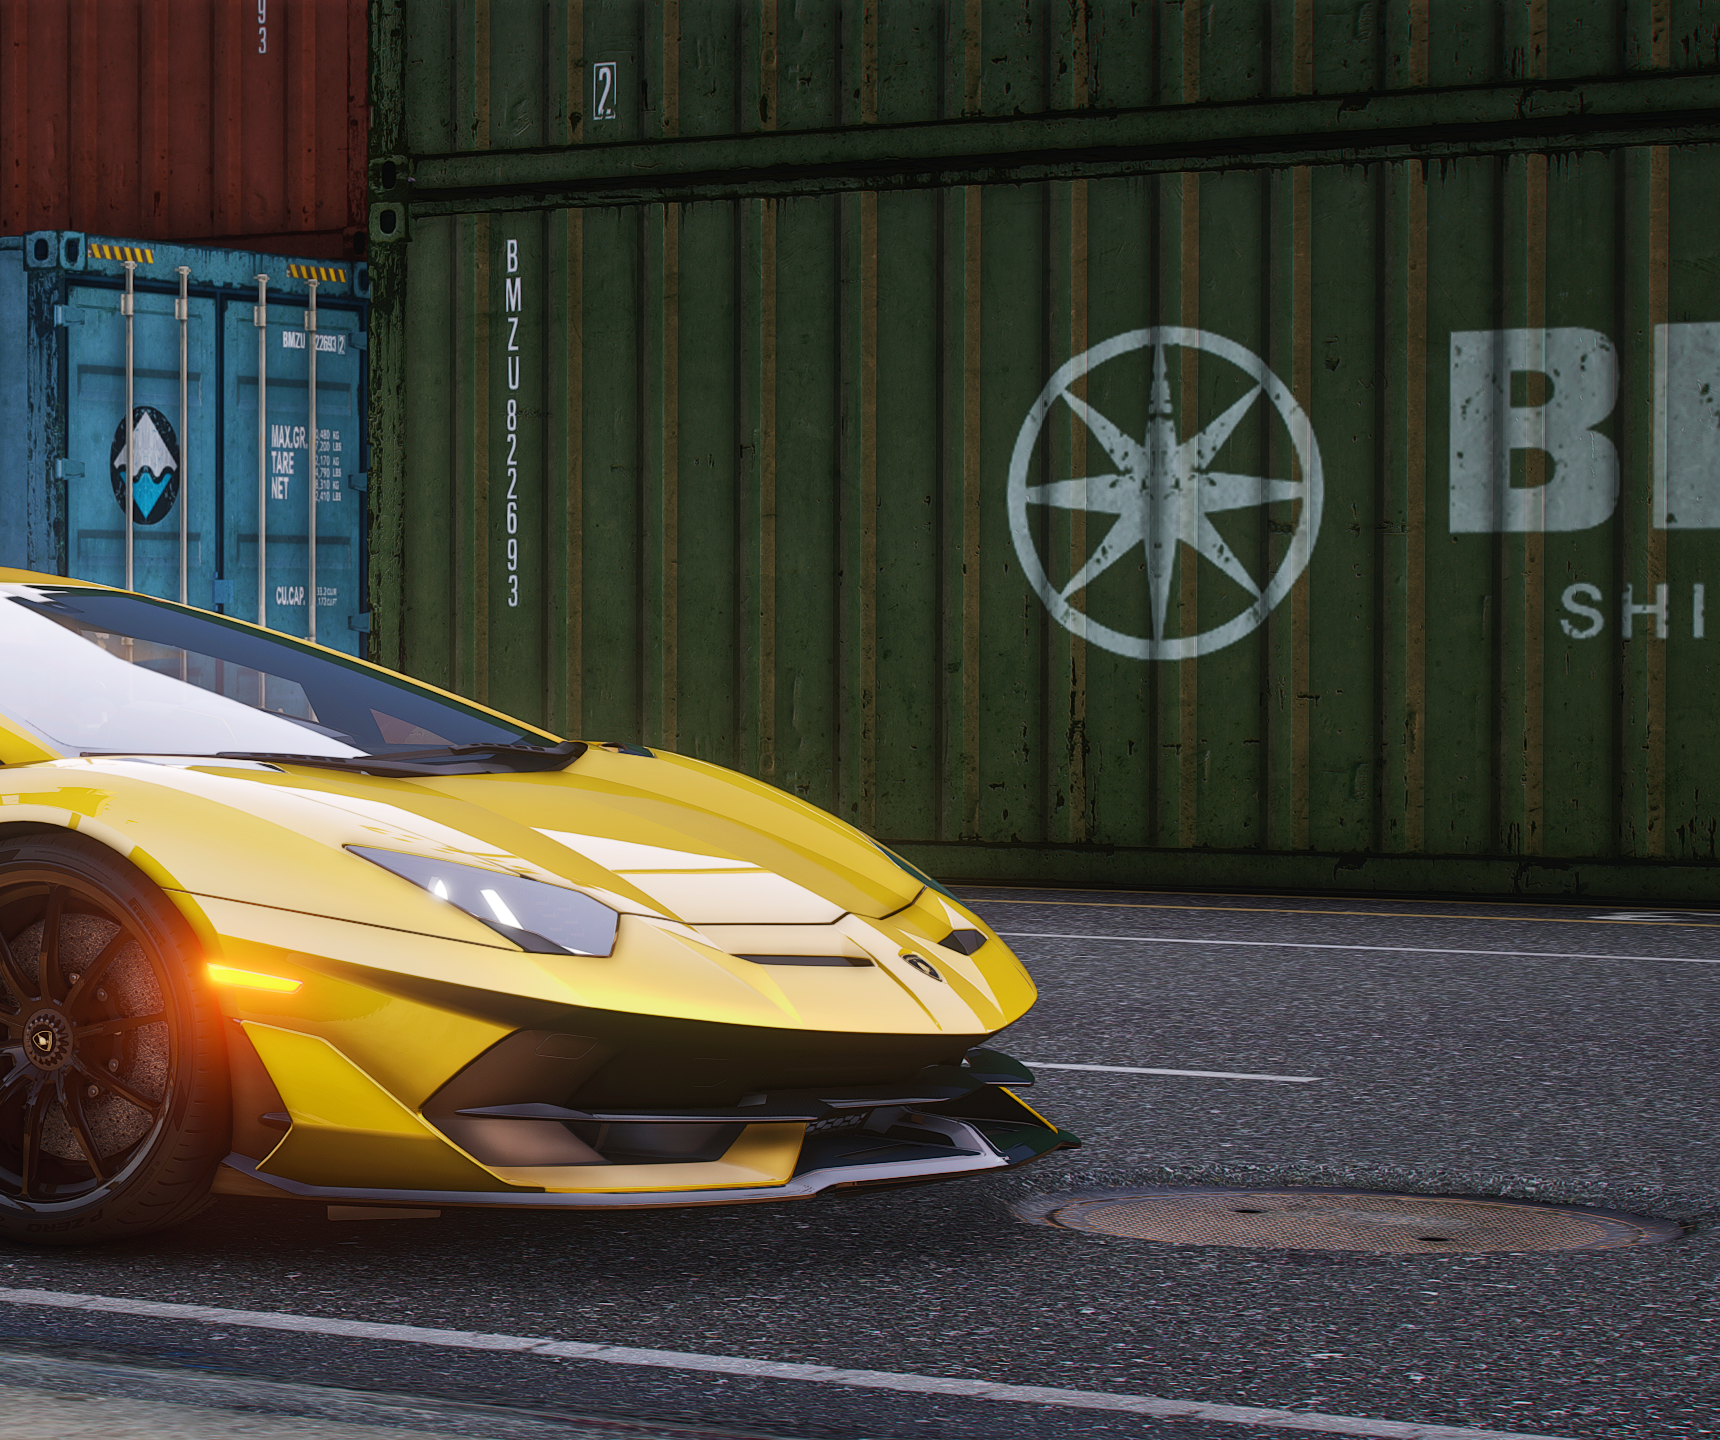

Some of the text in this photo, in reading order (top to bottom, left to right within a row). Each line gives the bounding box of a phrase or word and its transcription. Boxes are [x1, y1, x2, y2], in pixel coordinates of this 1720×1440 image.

[596, 65, 613, 117] 2
[282, 331, 306, 349] BMZU
[271, 424, 308, 449] MAX.GR.
[270, 450, 295, 475] TARE
[271, 476, 290, 500] NET
[275, 586, 306, 606] CU.CAP.
[26, 1216, 86, 1233] ZERO
